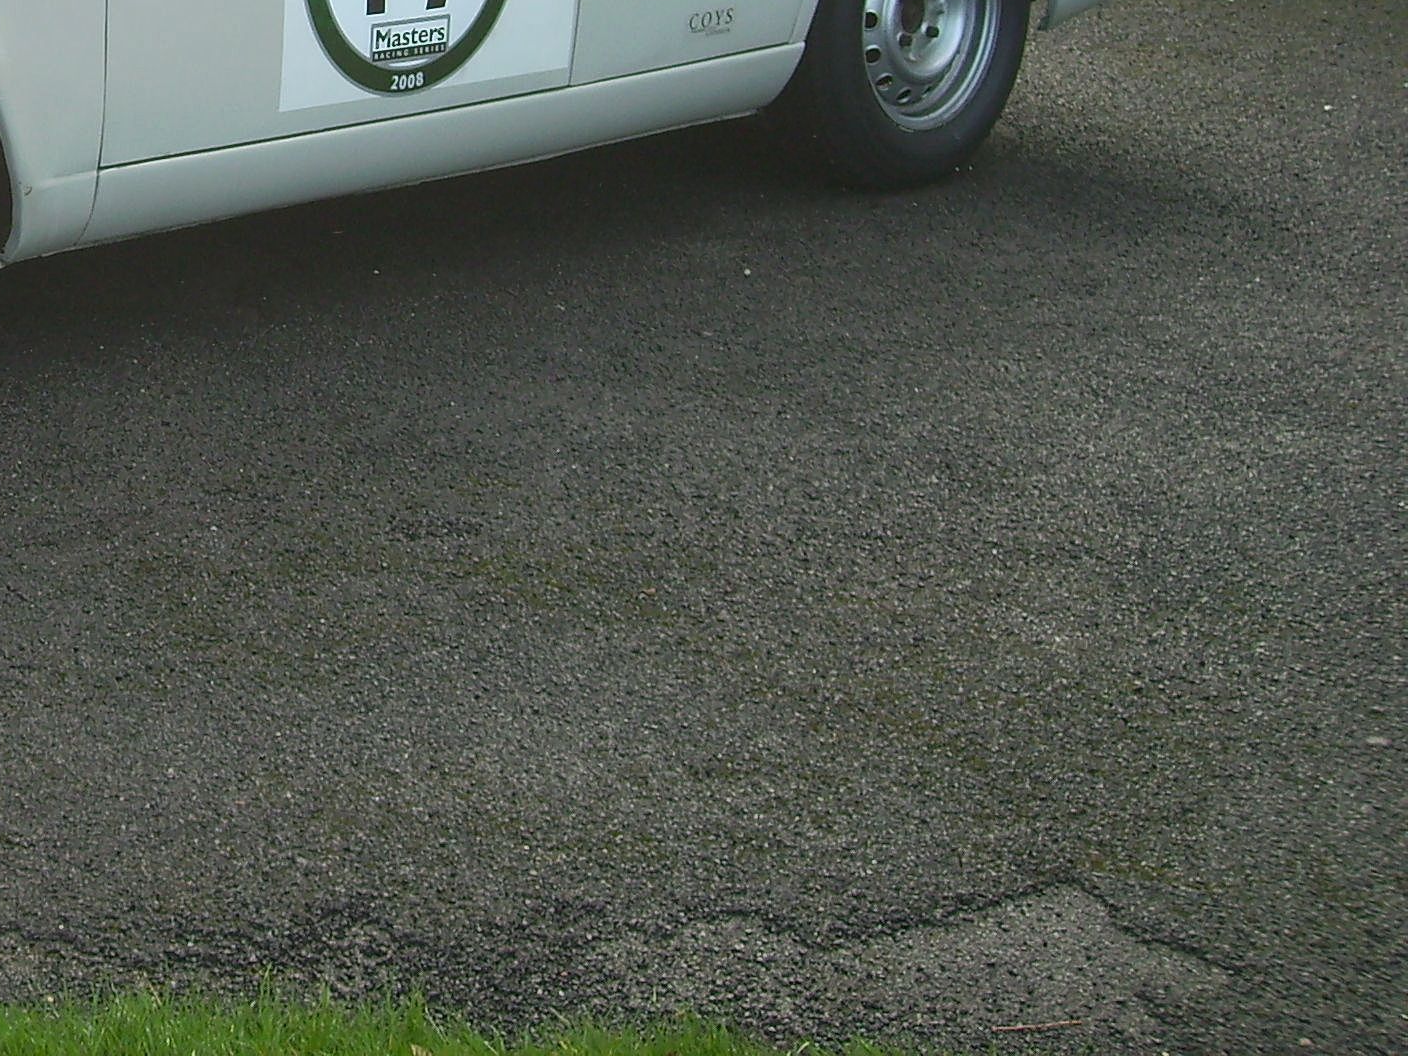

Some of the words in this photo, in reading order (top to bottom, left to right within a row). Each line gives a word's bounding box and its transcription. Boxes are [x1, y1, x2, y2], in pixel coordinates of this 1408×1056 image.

[689, 7, 735, 31] COYS
[375, 27, 445, 50] Masters
[373, 48, 410, 61] RACING
[390, 71, 424, 90] 2008
